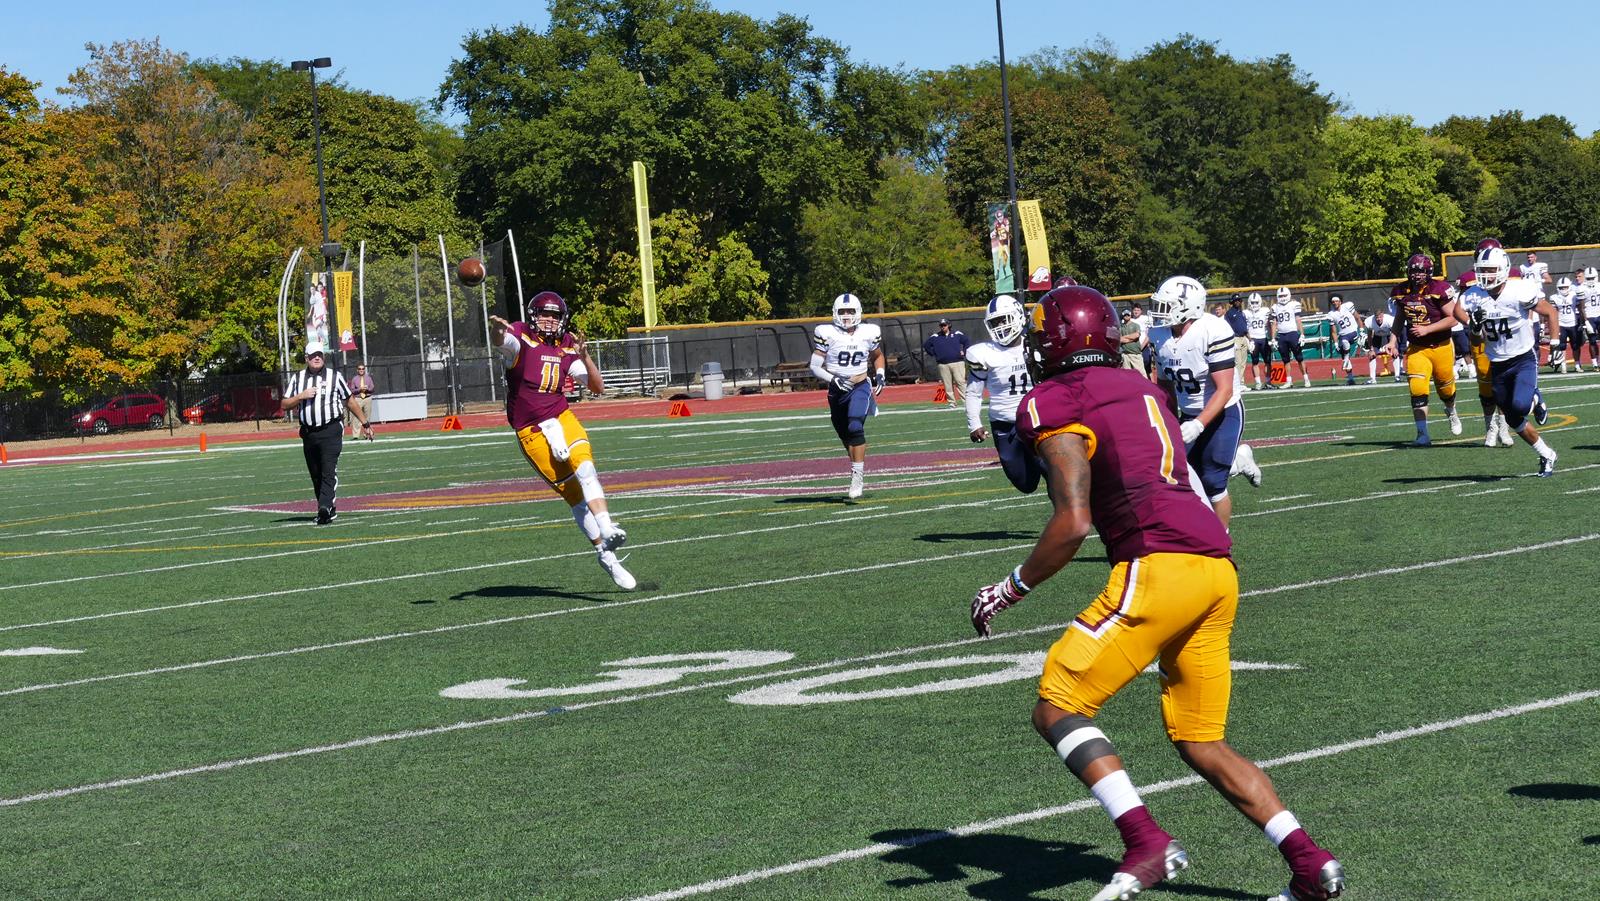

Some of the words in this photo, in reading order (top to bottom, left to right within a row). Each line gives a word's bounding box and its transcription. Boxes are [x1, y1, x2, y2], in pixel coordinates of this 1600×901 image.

[1176, 282, 1194, 299] T
[1278, 312, 1291, 323] 83
[1338, 316, 1351, 330] 23
[1486, 318, 1512, 341] 94
[1072, 354, 1104, 364] XENITH
[538, 361, 560, 393] 11
[1009, 374, 1027, 395] 11
[670, 403, 680, 416] 10
[1027, 397, 1041, 428] 1
[1143, 394, 1179, 485] 1
